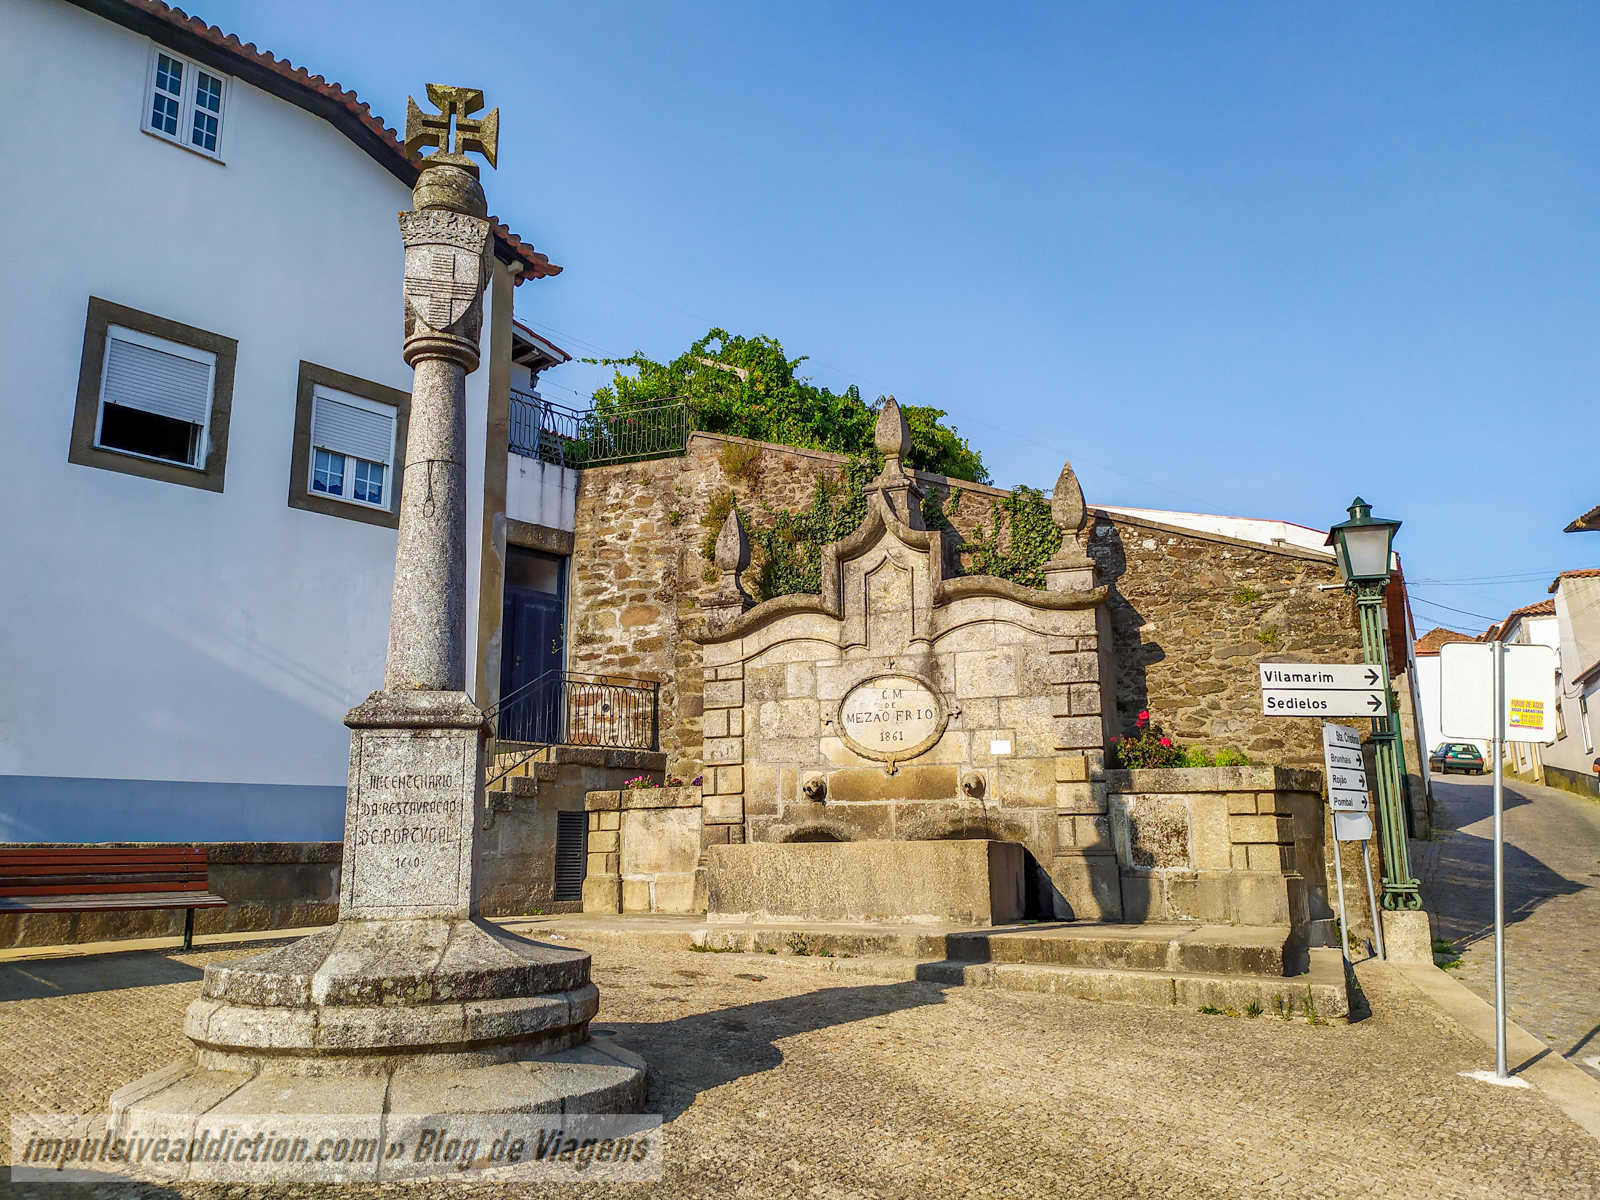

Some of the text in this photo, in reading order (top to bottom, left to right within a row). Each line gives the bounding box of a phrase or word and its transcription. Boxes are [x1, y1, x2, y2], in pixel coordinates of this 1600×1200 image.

[1264, 670, 1334, 683] Vilamarim
[884, 701, 896, 709] DE
[1267, 696, 1328, 709] Sedielos
[896, 708, 933, 721] FRIO
[880, 730, 904, 742] 1861
[1330, 753, 1352, 765] Brunhais
[1333, 796, 1354, 807] Pombal
